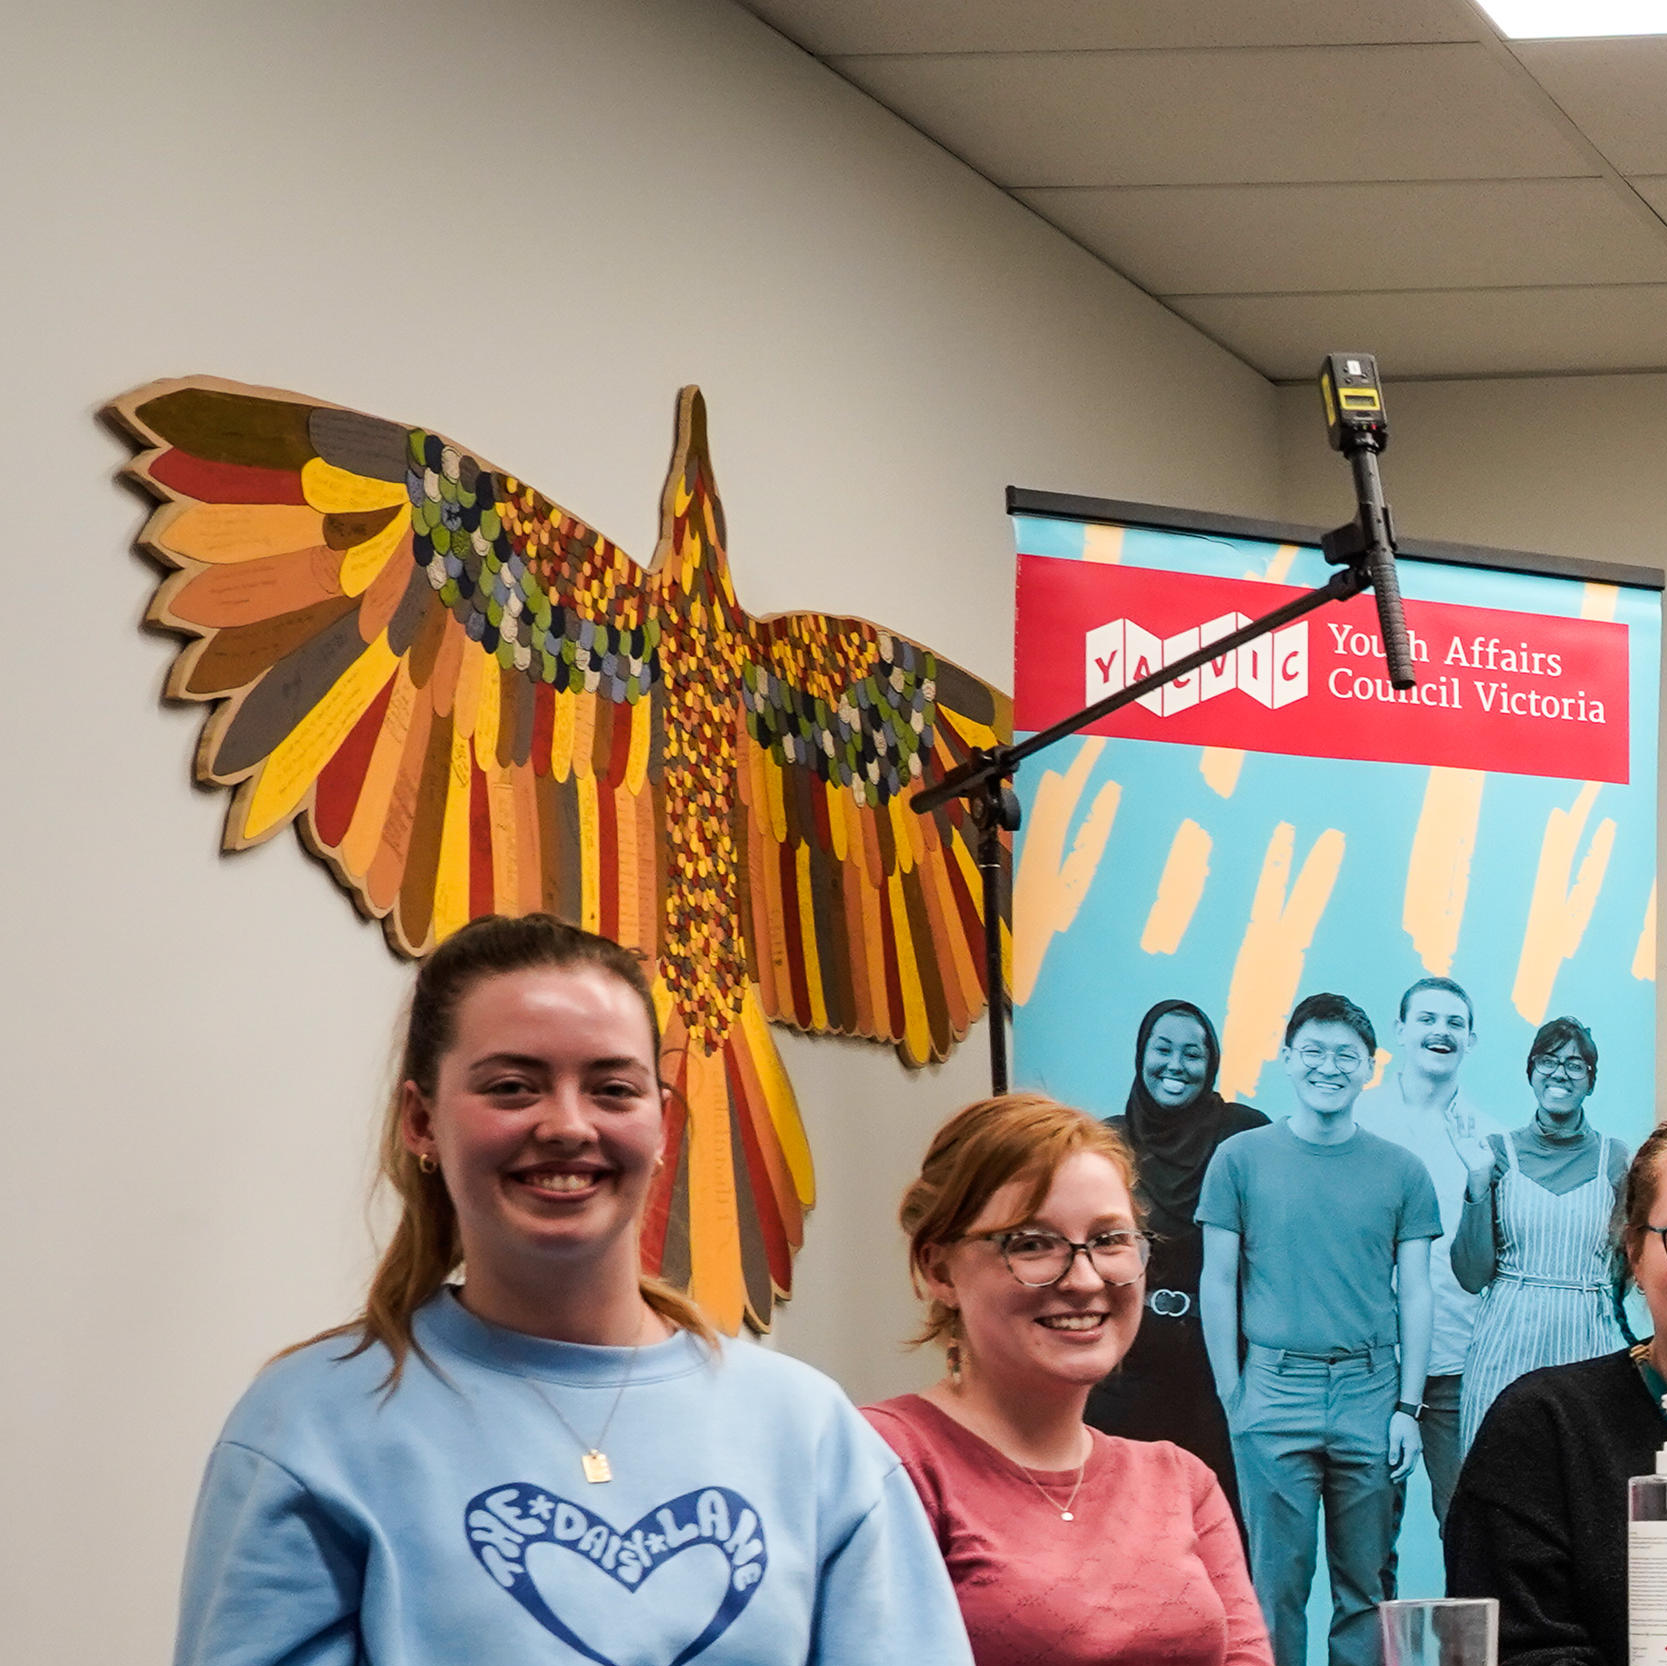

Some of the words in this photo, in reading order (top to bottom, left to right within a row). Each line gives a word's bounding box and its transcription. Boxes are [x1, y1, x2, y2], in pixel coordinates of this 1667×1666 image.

[1327, 622, 1430, 662] Youh
[1444, 636, 1562, 677] Affairs
[1328, 667, 1463, 708] Council
[1474, 681, 1606, 723] Victoria
[553, 1502, 655, 1584] DAISY
